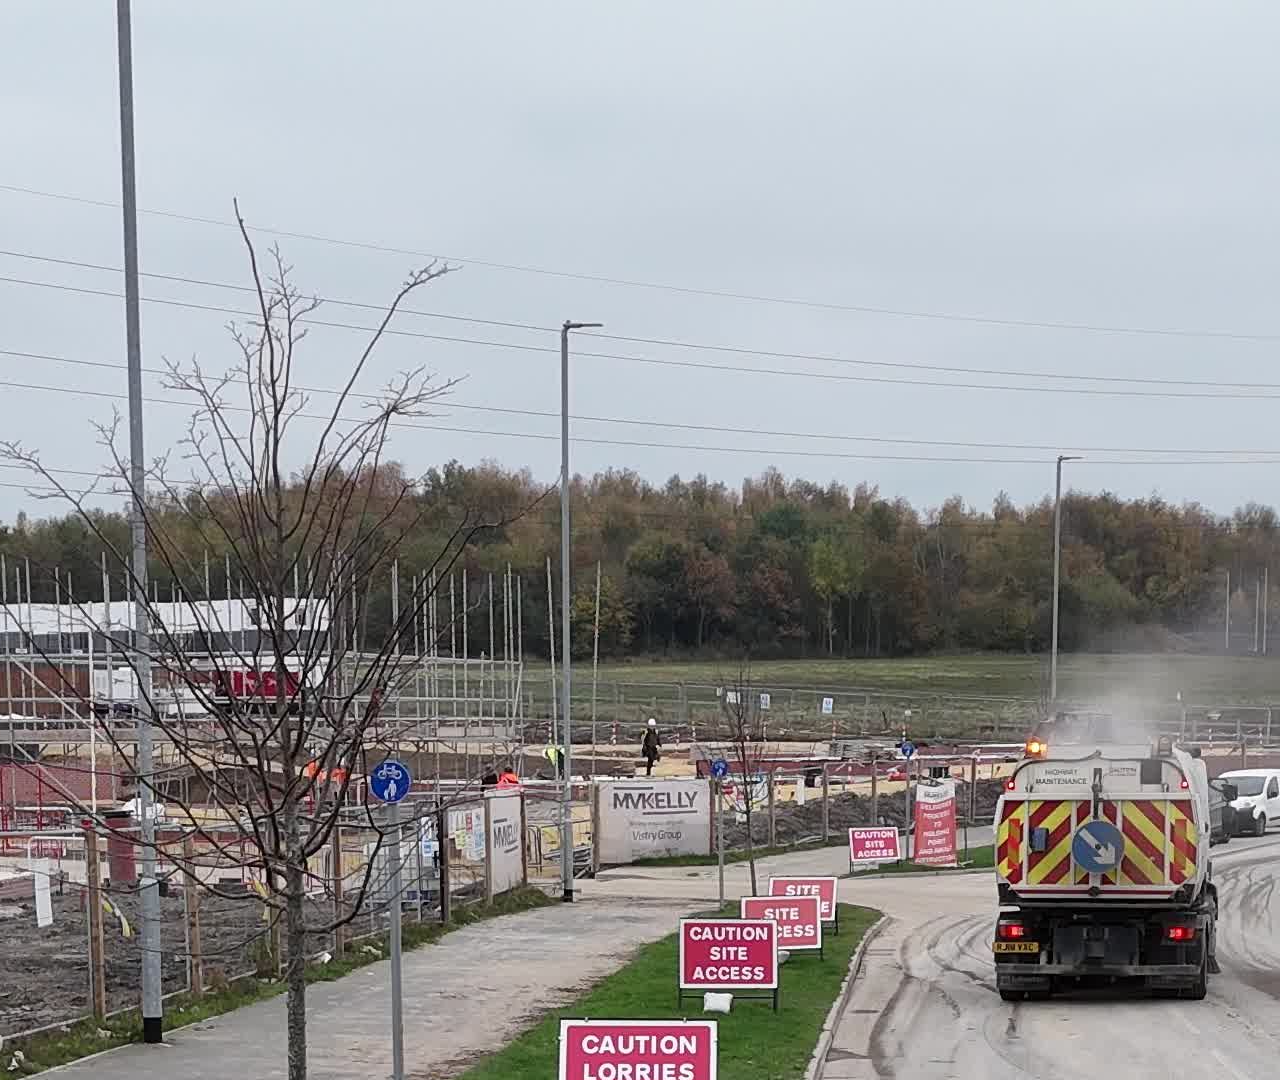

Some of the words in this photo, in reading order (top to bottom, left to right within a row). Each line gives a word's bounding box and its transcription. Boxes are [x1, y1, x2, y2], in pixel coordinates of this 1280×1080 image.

[632, 831, 657, 842] Vistry
[658, 830, 682, 841] Group
[854, 830, 894, 839] CAUTION
[865, 840, 885, 848] SITE
[857, 849, 894, 858] ACCESS
[785, 885, 820, 896] SITE
[764, 908, 799, 920] SITE
[689, 926, 768, 941] CAUTION
[709, 946, 748, 961] SITE
[692, 966, 765, 980] ACCESS
[581, 1034, 697, 1054] CAUTION
